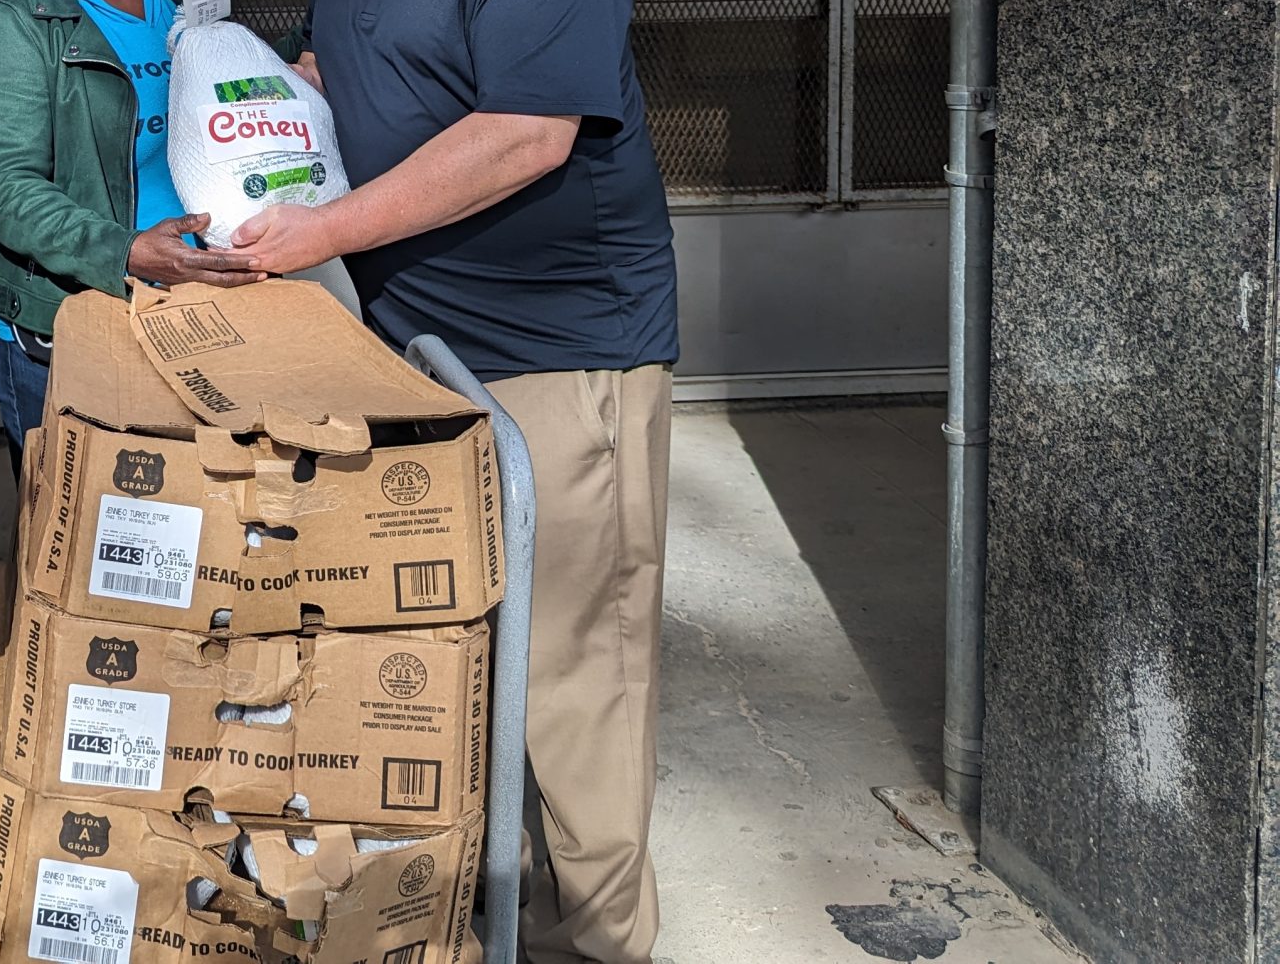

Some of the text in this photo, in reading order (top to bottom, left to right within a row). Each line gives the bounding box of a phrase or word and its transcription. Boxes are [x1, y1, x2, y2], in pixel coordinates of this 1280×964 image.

[236, 109, 267, 120] THE
[208, 111, 312, 151] Coney
[175, 368, 240, 413] PERISHABLE
[128, 455, 154, 465] USDA
[132, 465, 145, 480] A
[384, 463, 428, 483] INSPECTED
[121, 481, 155, 492] GRADE
[397, 476, 415, 486] U.S.
[45, 429, 77, 574] PRODUCT OF U.S.A.
[130, 510, 151, 519] TURKEY
[153, 513, 170, 522] STORE
[377, 511, 399, 519] WEIGHT
[482, 442, 499, 588] PRODUCT OF U.S.A.
[380, 517, 440, 528] CONSUMER PACKAGE
[398, 529, 421, 537] DISPLAY
[102, 545, 143, 564] 1443
[157, 569, 188, 582] 59.03
[197, 566, 239, 585] READ
[237, 577, 255, 592] TO
[304, 565, 370, 583] TURKEY
[101, 642, 127, 651] USDA
[106, 652, 118, 666] A
[382, 655, 424, 675] INSPECTED
[95, 667, 129, 678] GRADE
[396, 668, 412, 679] U.S.
[14, 619, 41, 761] PRODUCT OF U.S.A.
[392, 688, 411, 696] P-544
[97, 699, 117, 708] TURKEY
[120, 702, 136, 711] STORE
[469, 648, 484, 794] PRODUCT OF U.S.A.
[70, 735, 111, 752] 1443
[126, 758, 156, 769] 57.36
[173, 746, 223, 762] READY
[228, 748, 248, 766] TO
[297, 752, 359, 769] TURKEY
[74, 817, 100, 828] USDA
[78, 827, 90, 841] A
[67, 842, 101, 854] GRADE
[67, 874, 87, 885] TURKEY
[89, 878, 107, 888] STORE
[39, 909, 80, 929] 1443
[452, 905, 467, 964] RODUCT
[460, 882, 470, 901] OF
[94, 935, 124, 949] 56.18
[190, 942, 210, 956] TO
